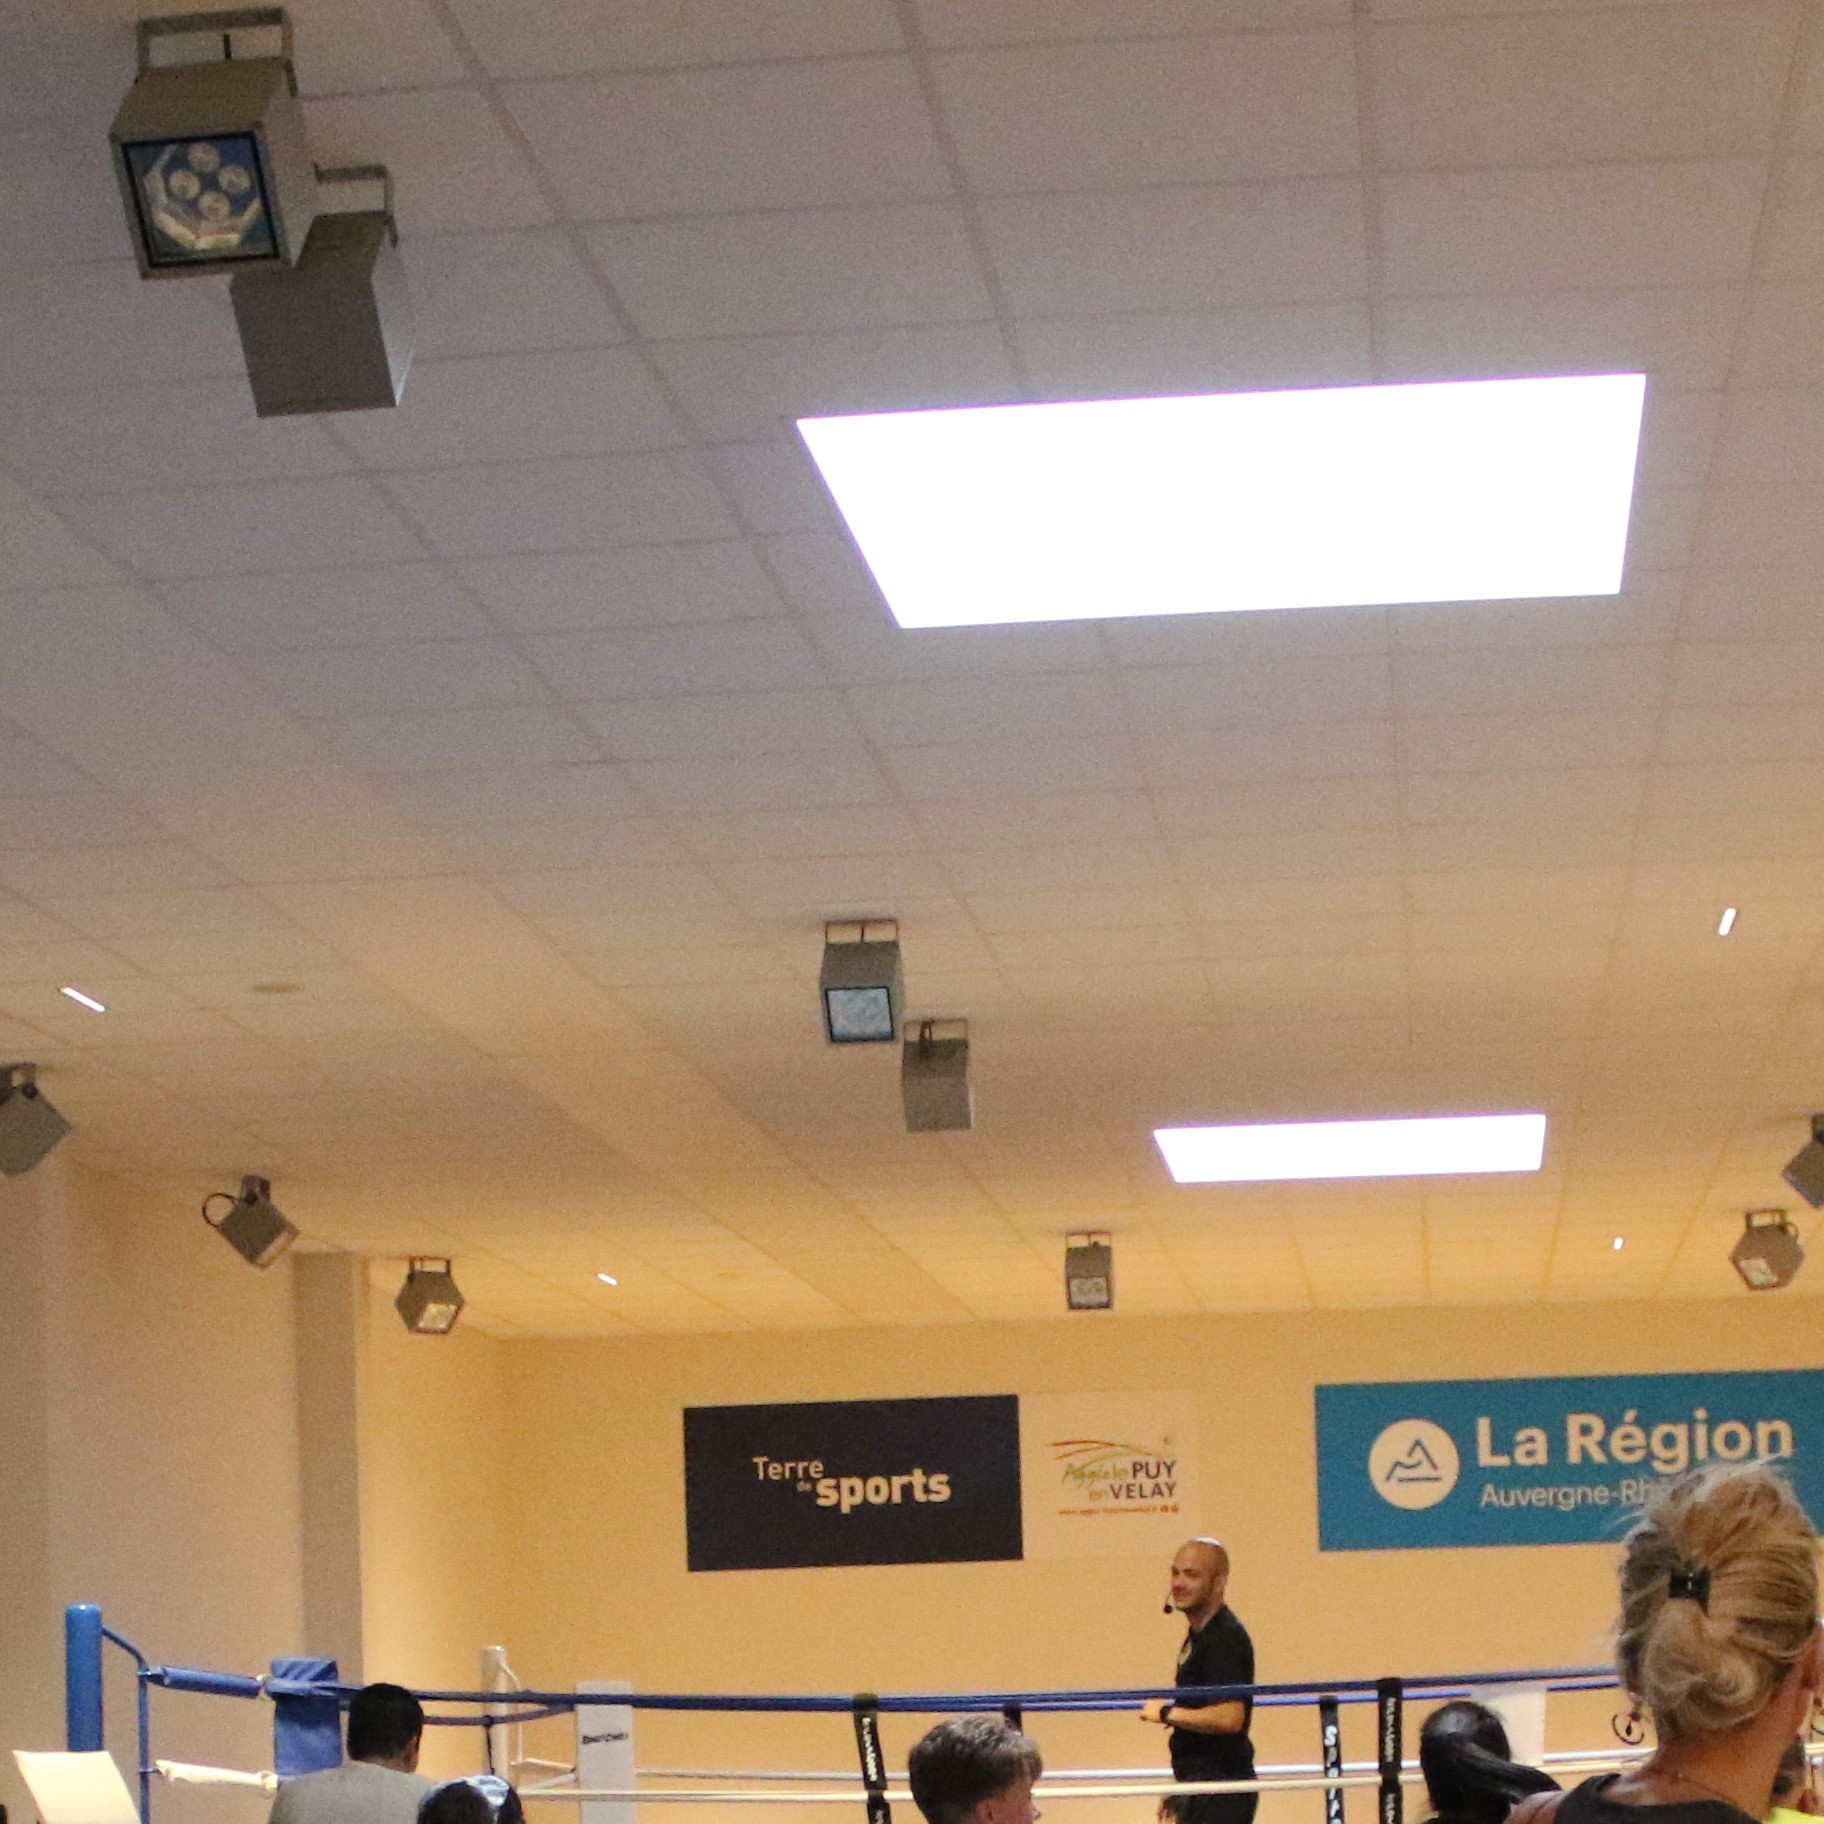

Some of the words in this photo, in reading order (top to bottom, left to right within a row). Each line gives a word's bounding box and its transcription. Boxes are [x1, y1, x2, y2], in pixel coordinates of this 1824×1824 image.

[1477, 1417, 1549, 1467] La
[1567, 1408, 1794, 1474] Région
[752, 1456, 824, 1480] Terre
[1132, 1461, 1175, 1480] PUY
[816, 1468, 952, 1514] sports
[1110, 1481, 1176, 1499] VELAY
